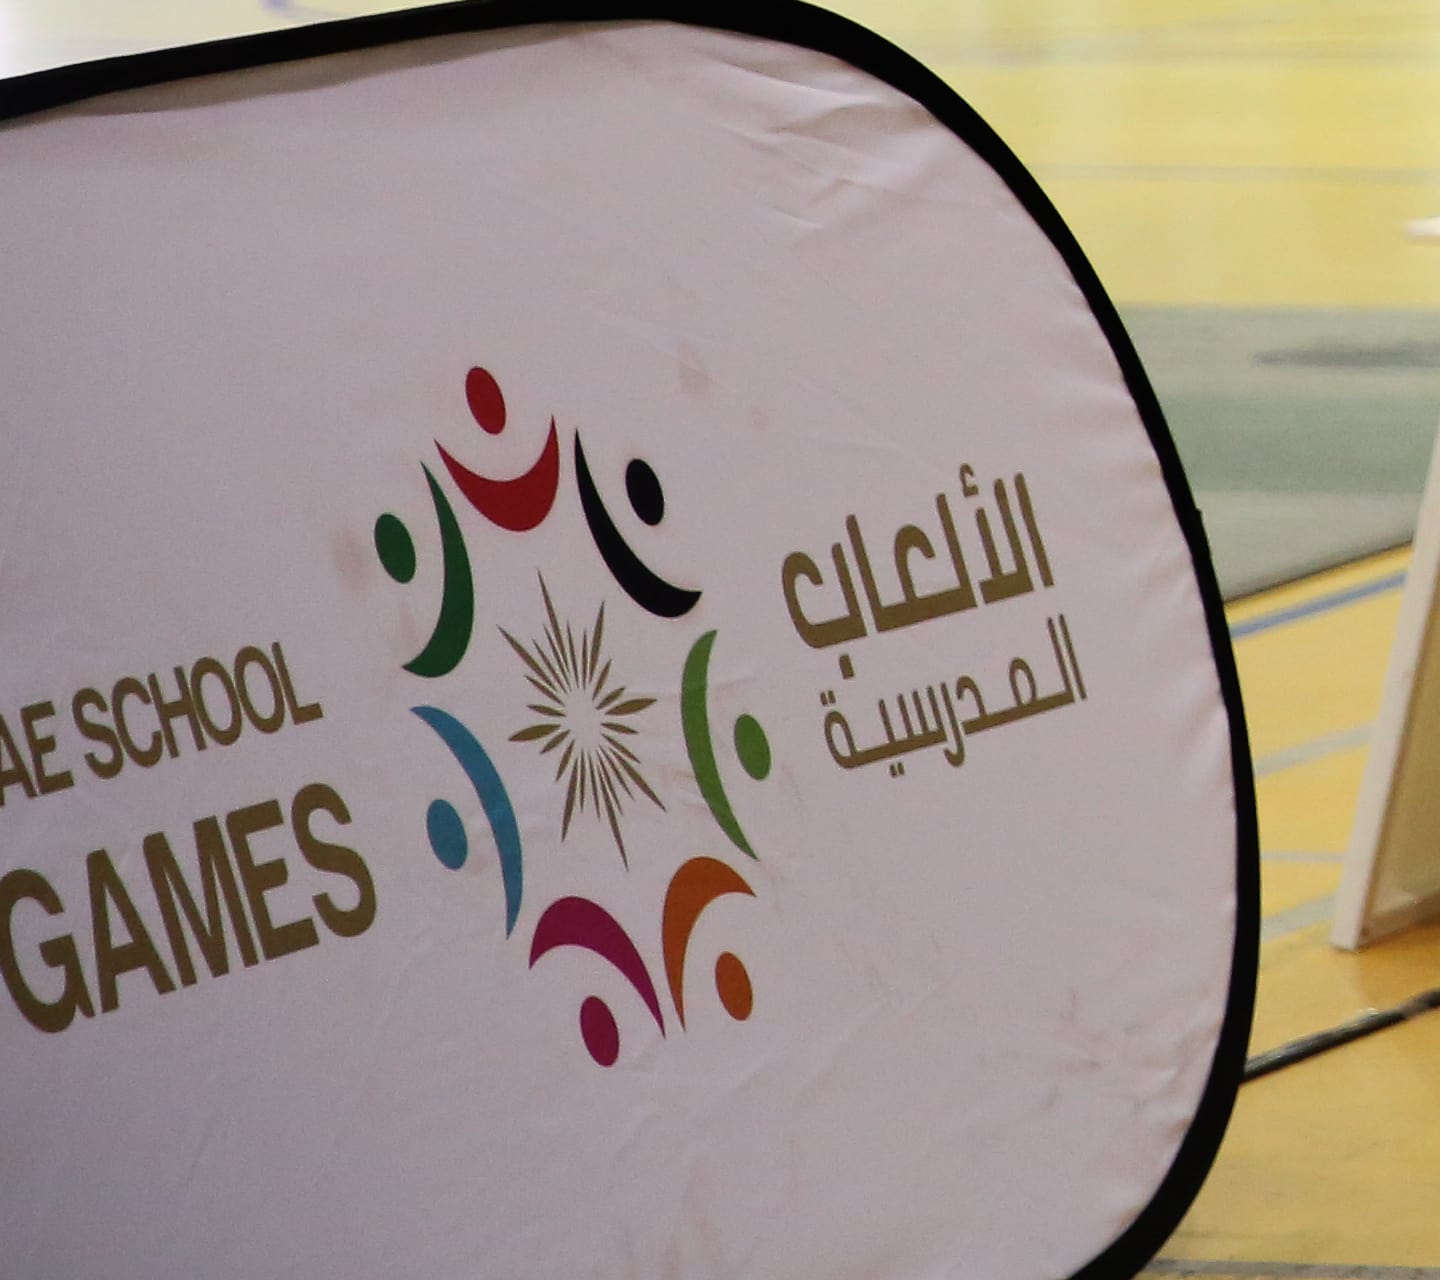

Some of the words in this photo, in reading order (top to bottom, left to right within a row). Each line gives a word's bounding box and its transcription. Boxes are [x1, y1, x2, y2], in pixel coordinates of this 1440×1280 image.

[781, 462, 1055, 680] الألعاب
[0, 700, 75, 808] AE
[71, 641, 325, 780] SCHOOL
[819, 612, 1088, 778] المدرسية
[0, 782, 378, 1034] GAMES
